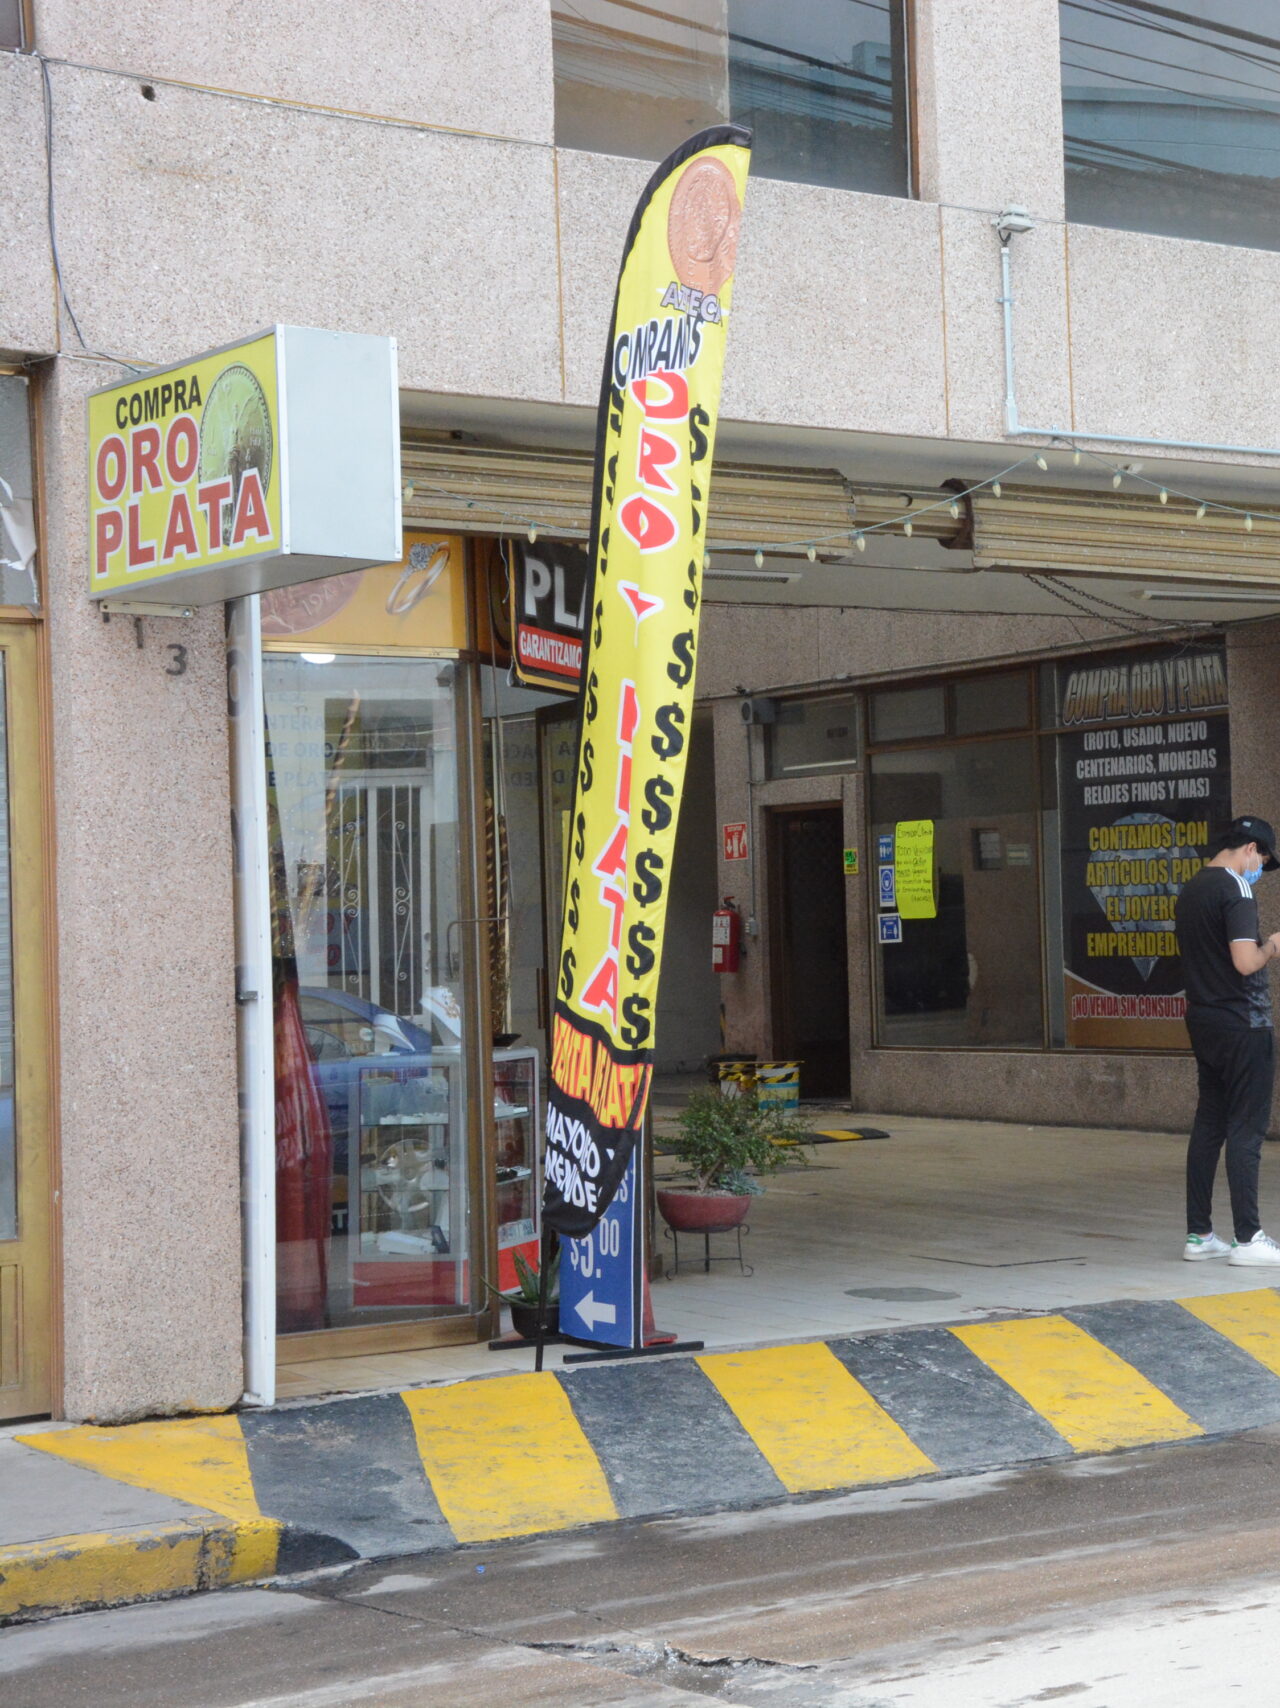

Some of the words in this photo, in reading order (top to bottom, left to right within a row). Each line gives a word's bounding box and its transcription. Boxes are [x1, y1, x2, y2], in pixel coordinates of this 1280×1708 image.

[116, 375, 202, 430] COMPRA
[97, 416, 199, 502] ORO
[97, 474, 270, 575] PLATA
[1063, 665, 1130, 726] COMPRA
[1130, 659, 1165, 719] ORO
[1175, 655, 1230, 711] PLATA
[1123, 725, 1166, 748] USADO,
[1168, 720, 1207, 742] NUEVO
[1076, 755, 1157, 780] CENTENARIOS,
[1158, 748, 1217, 773] MONEDAS
[1084, 782, 1129, 806] RELOJES
[1131, 781, 1165, 801] FINOS
[1166, 780, 1175, 799] Y
[1089, 822, 1172, 852] CONTAMOS
[1175, 821, 1208, 847] CON
[1172, 856, 1211, 884] PAR
[1106, 896, 1121, 921] EL
[1088, 994, 1119, 1018] VENDA
[1121, 994, 1137, 1018] SIN
